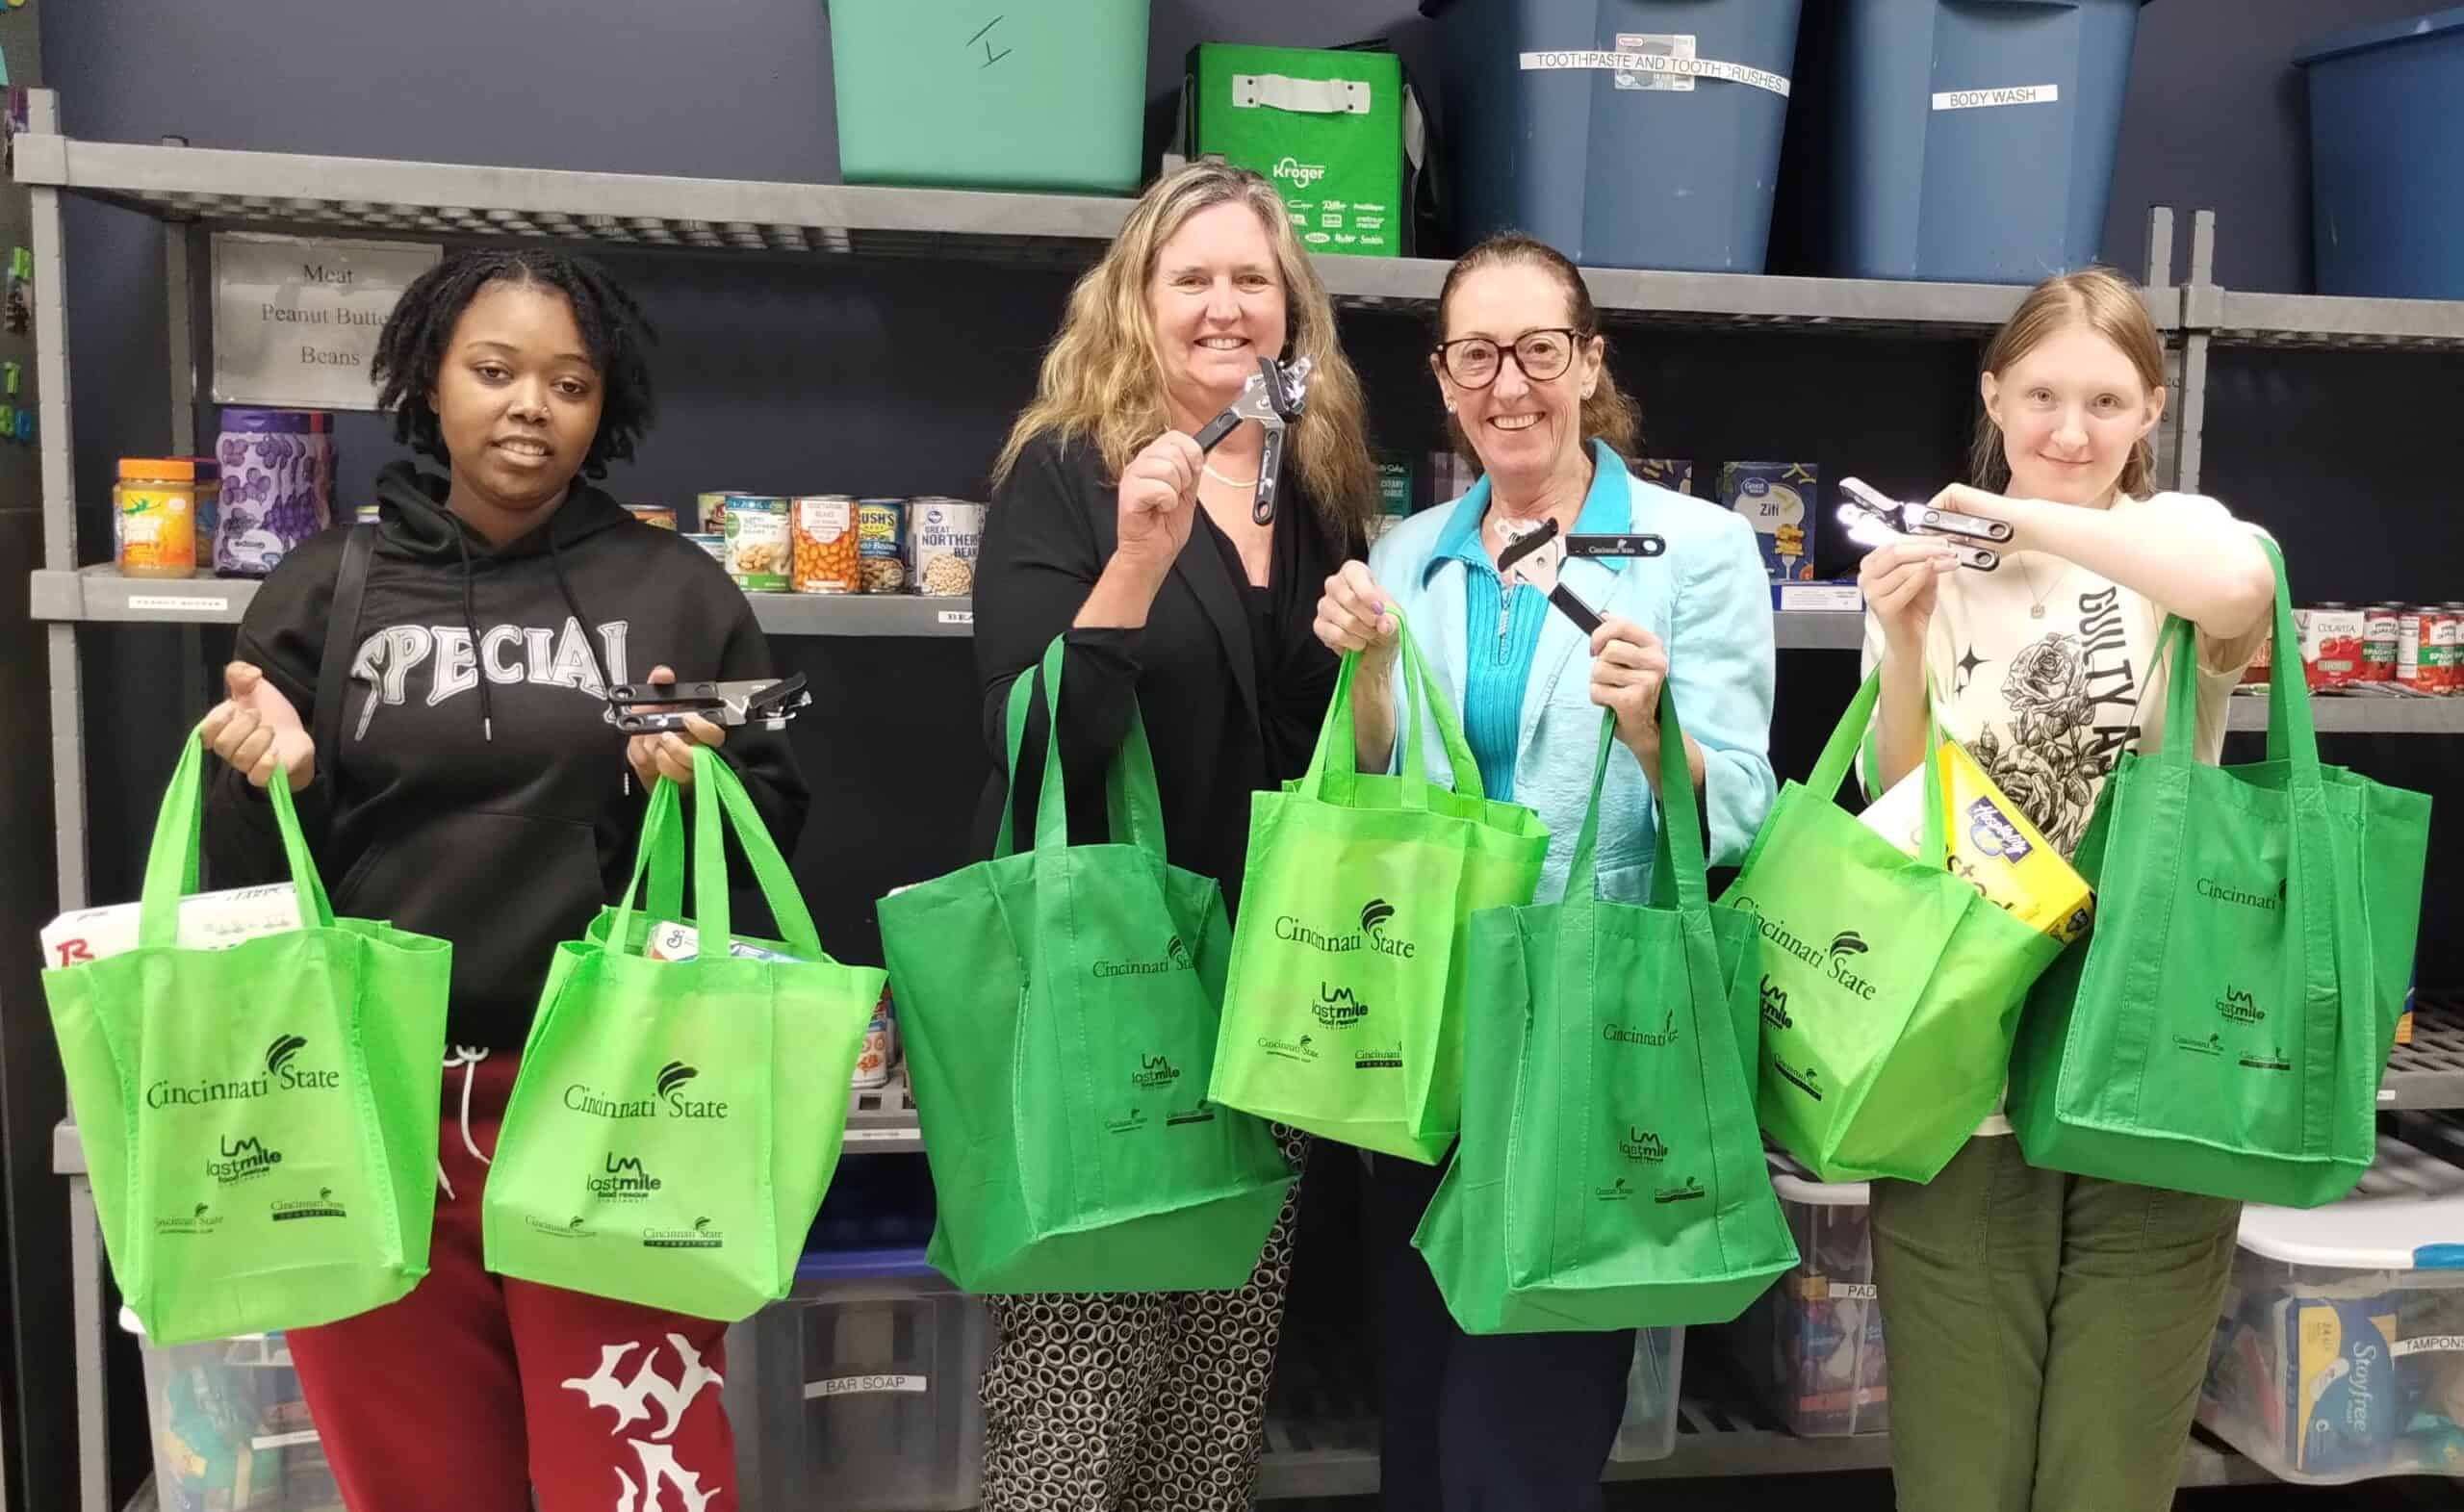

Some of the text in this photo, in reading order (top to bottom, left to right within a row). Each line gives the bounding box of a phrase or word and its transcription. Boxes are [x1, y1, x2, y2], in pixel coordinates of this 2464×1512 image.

[1537, 53, 1630, 68] TOOTHPASTE
[1635, 56, 1665, 70] AND
[1949, 89, 2037, 107] BODY WASH
[1272, 157, 1325, 189] Kroger
[303, 265, 353, 284] Meat
[262, 303, 388, 325] Peanut Butte
[300, 346, 361, 366] Beans
[2079, 586, 2138, 706] GUILTY
[2196, 878, 2277, 910] Cincinnati
[1275, 915, 1416, 960] Cincinnati State
[1733, 896, 1877, 1001] Cncinnati State
[1093, 959, 1169, 978] Cincinnati
[1603, 1023, 1665, 1047] Cincinnati
[146, 1064, 340, 1110] Cincinnati State
[564, 1084, 729, 1119] Cincinnati State
[826, 1376, 906, 1393] BAR SOAP
[2348, 1342, 2377, 1433] Stayfree
